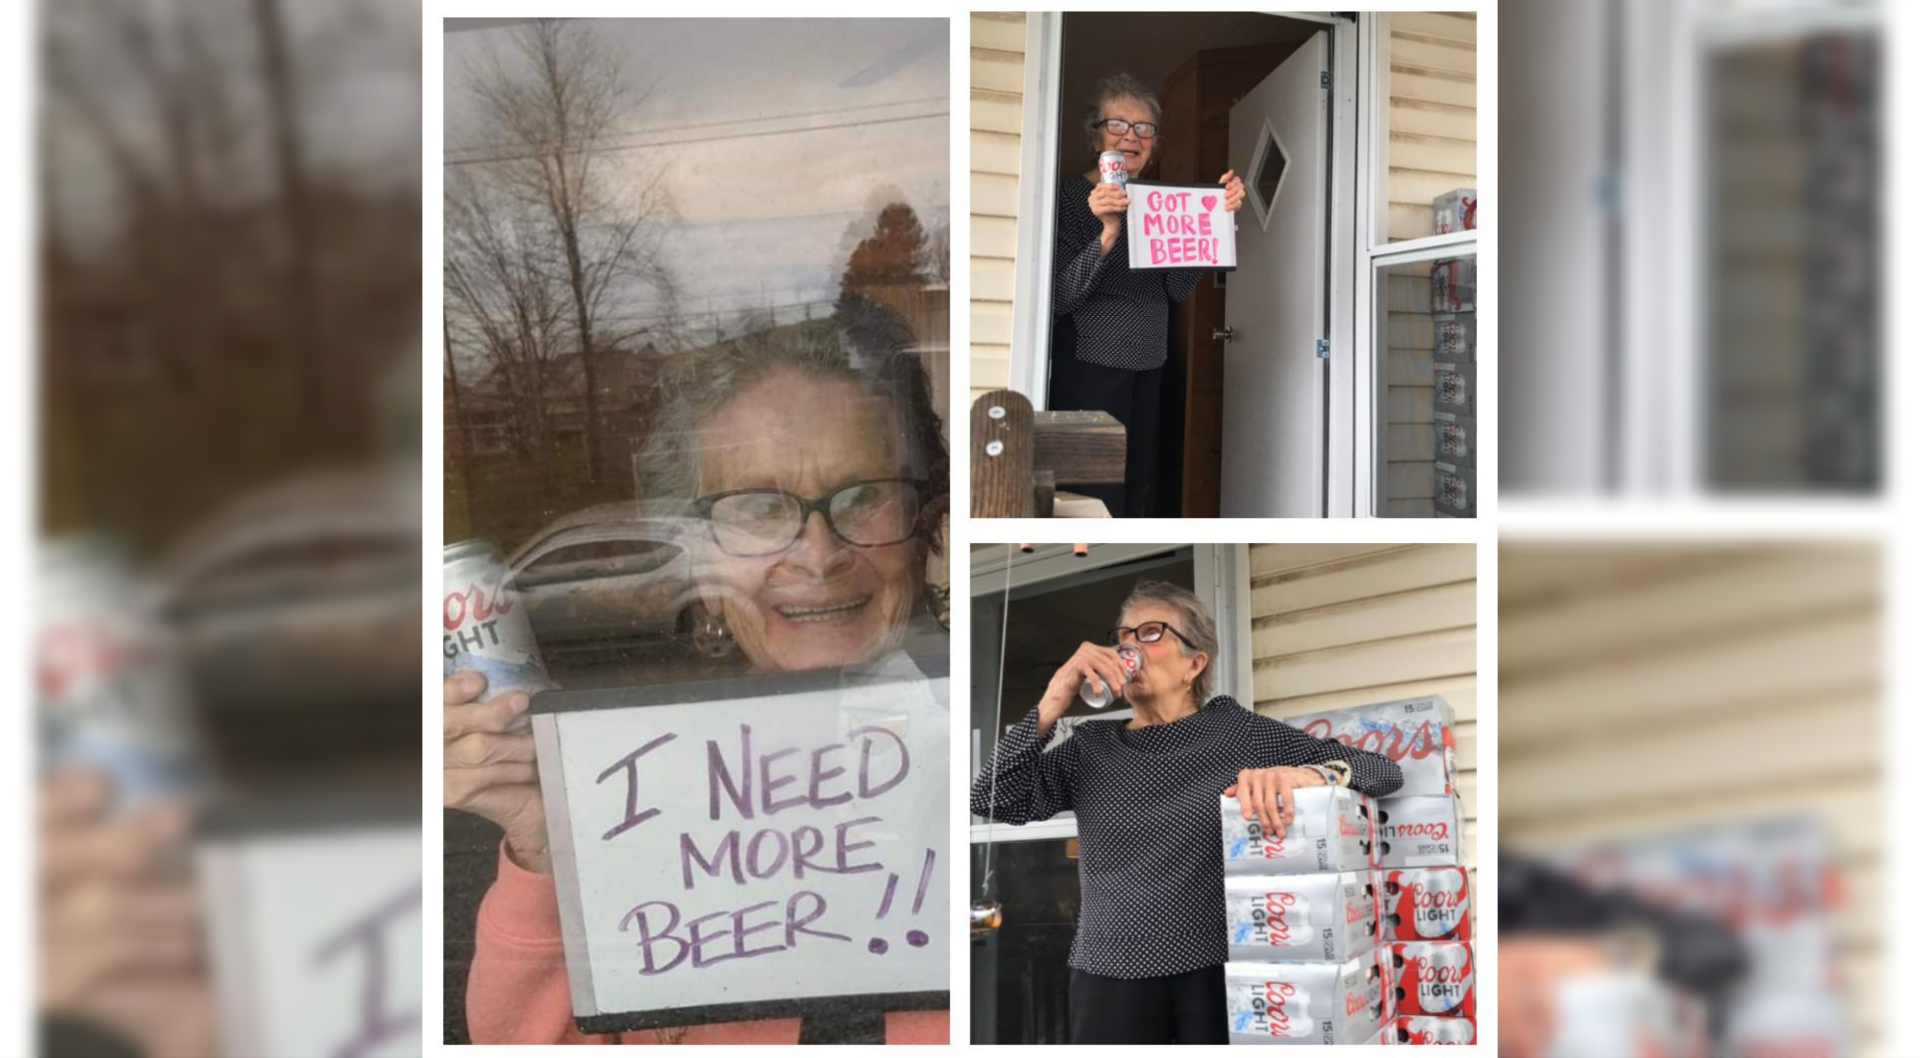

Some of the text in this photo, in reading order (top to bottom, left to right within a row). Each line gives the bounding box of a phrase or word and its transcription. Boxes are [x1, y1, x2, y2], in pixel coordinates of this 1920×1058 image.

[1147, 191, 1192, 212] GOT
[1144, 213, 1212, 236] MORE
[1150, 237, 1219, 265] BEER!
[443, 620, 500, 659] GHT
[1404, 704, 1414, 713] 15
[596, 723, 911, 840] I NEED
[1247, 812, 1263, 856] IGHT
[1398, 822, 1449, 841] Coors
[680, 816, 884, 889] MORE
[1316, 838, 1327, 849] 15
[1439, 844, 1450, 853] 15
[1251, 896, 1269, 943] LIGHT
[1416, 909, 1457, 922] LIGHT
[1323, 928, 1333, 939] 15
[1420, 984, 1460, 997] LIGHT
[1251, 985, 1269, 1033] LIGHT
[1322, 1021, 1333, 1032] 15
